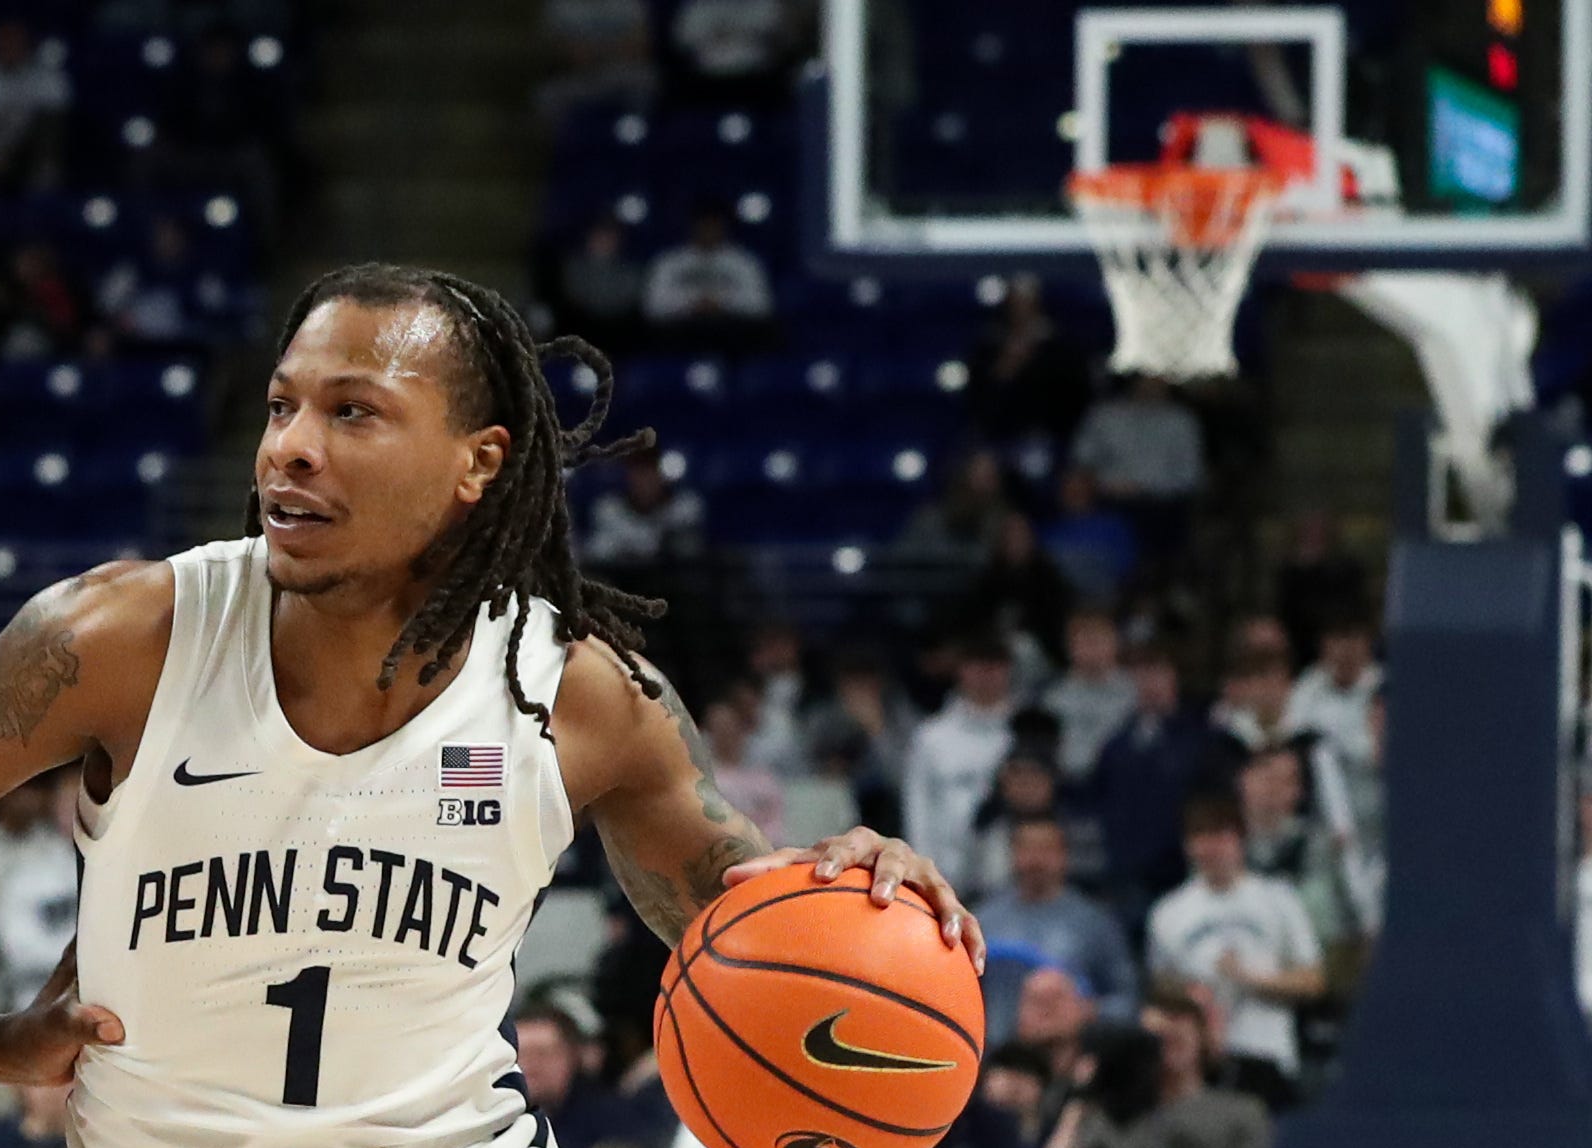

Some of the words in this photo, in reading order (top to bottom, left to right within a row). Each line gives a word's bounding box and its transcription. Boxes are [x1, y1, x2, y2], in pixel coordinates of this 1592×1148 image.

[129, 849, 298, 950] PENN
[317, 845, 500, 969] STATE
[266, 966, 331, 1107] 1
